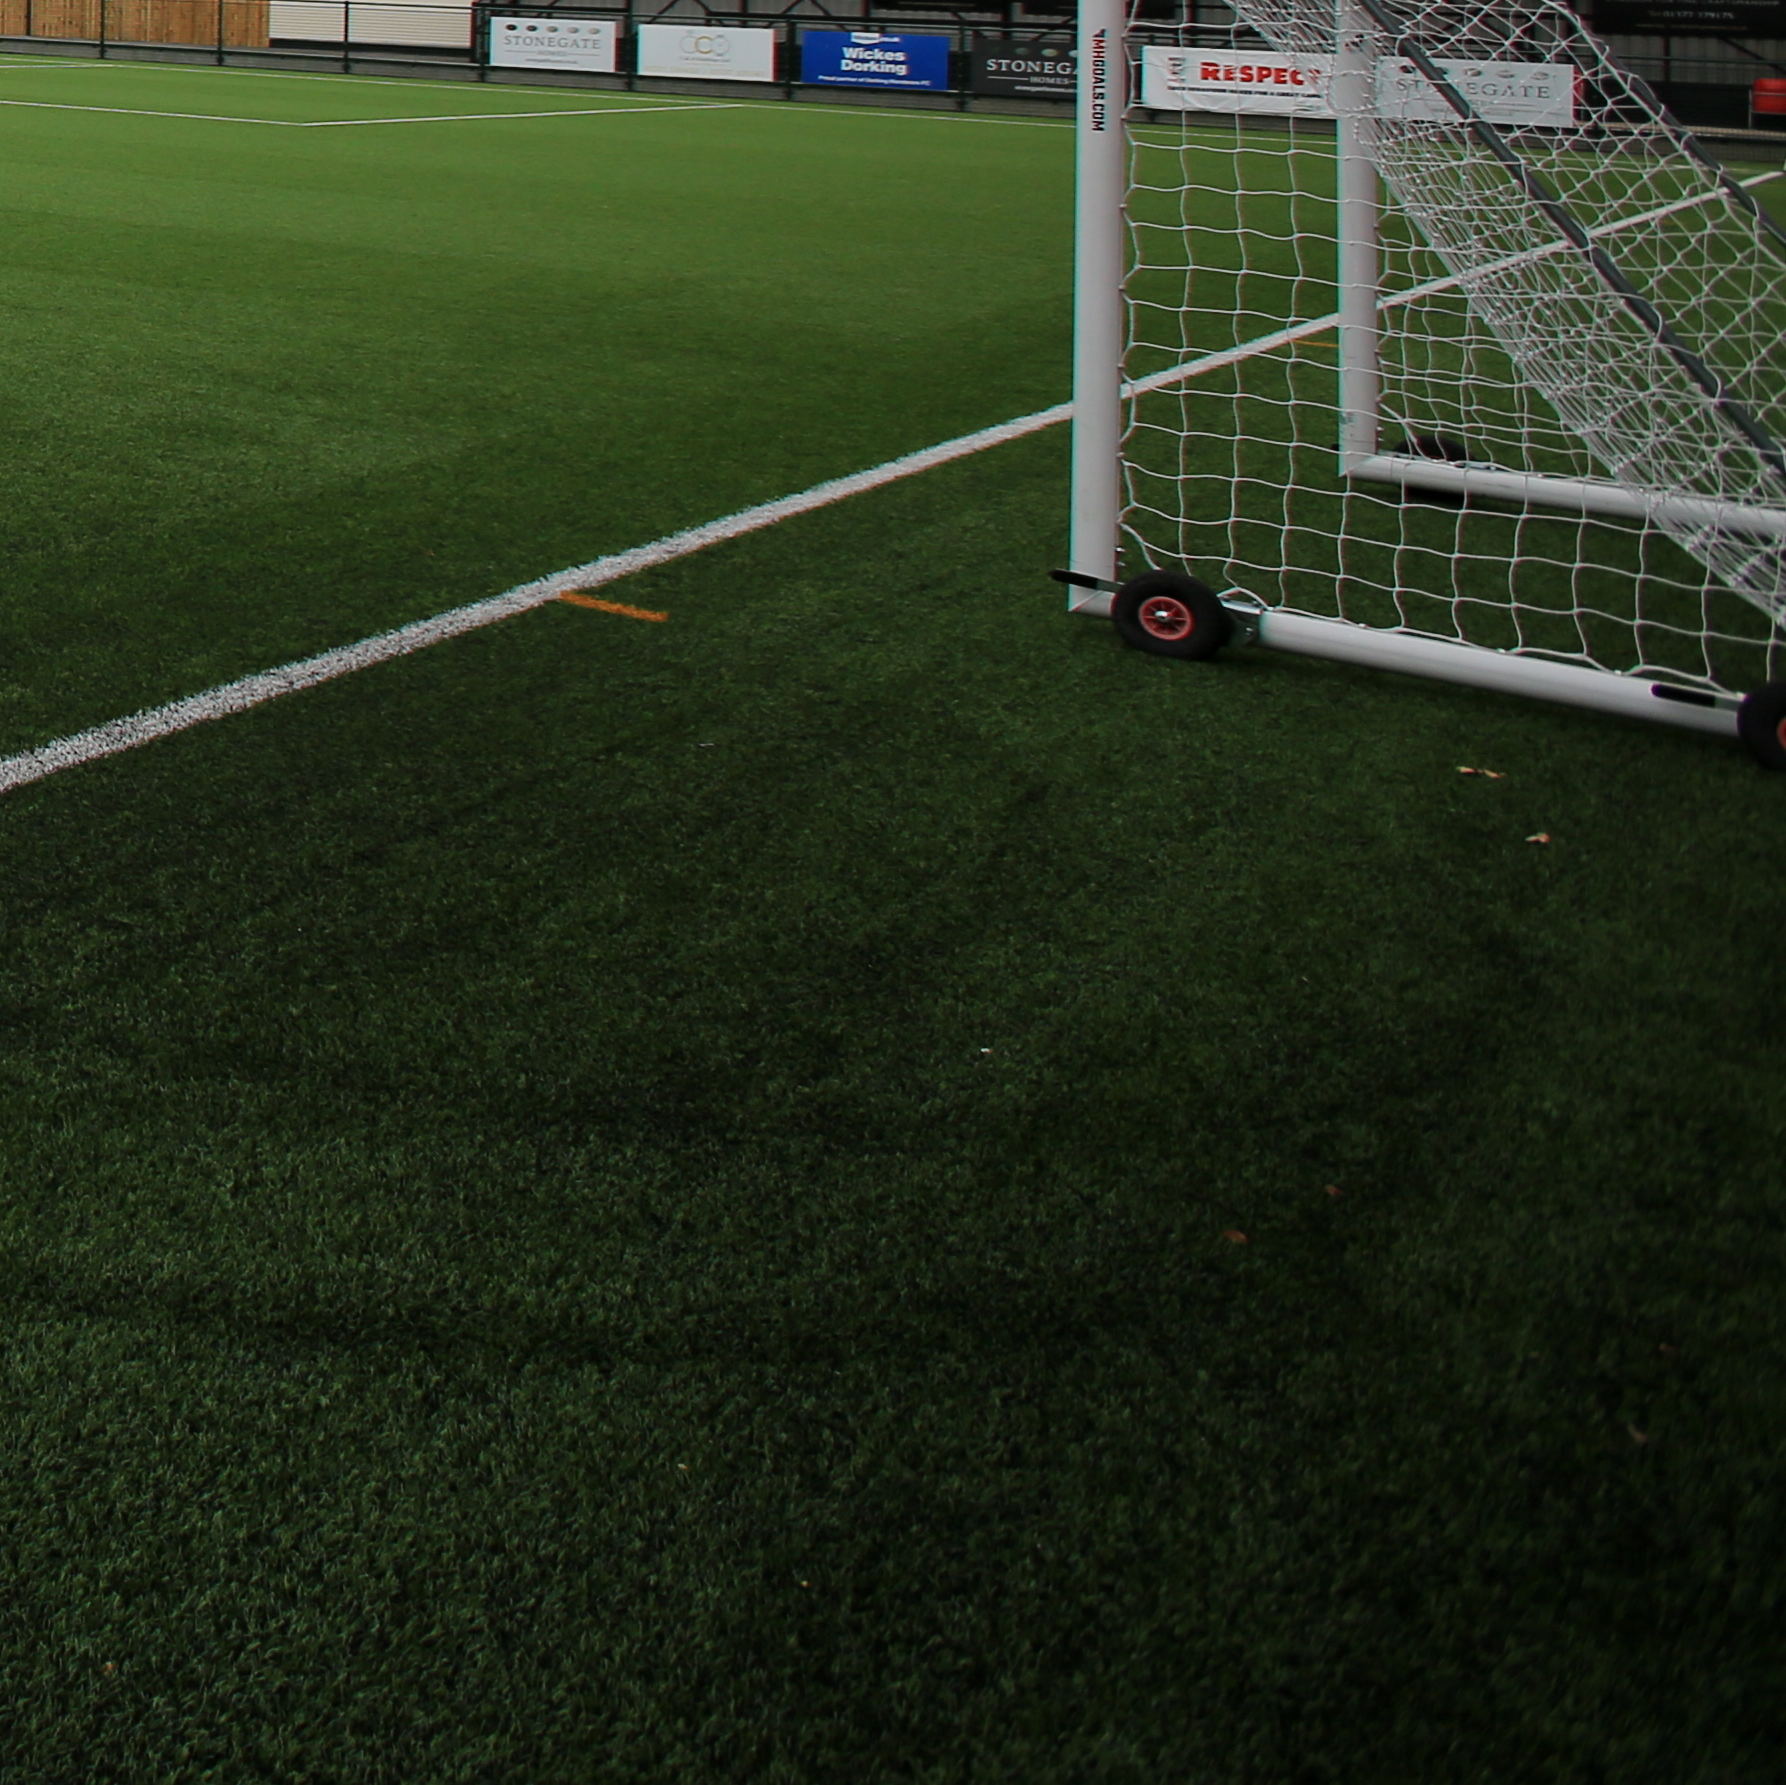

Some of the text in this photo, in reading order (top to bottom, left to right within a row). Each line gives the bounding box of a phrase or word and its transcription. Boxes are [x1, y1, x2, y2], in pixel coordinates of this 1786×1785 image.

[504, 35, 602, 50] STONEGATE
[842, 47, 907, 61] Wickes
[840, 59, 909, 76] Dorking
[986, 58, 1077, 75] STONEG
[1030, 76, 1070, 85] HOMES
[1092, 38, 1106, 132] MHGOALS.COM
[1396, 77, 1550, 99] STEGATE
